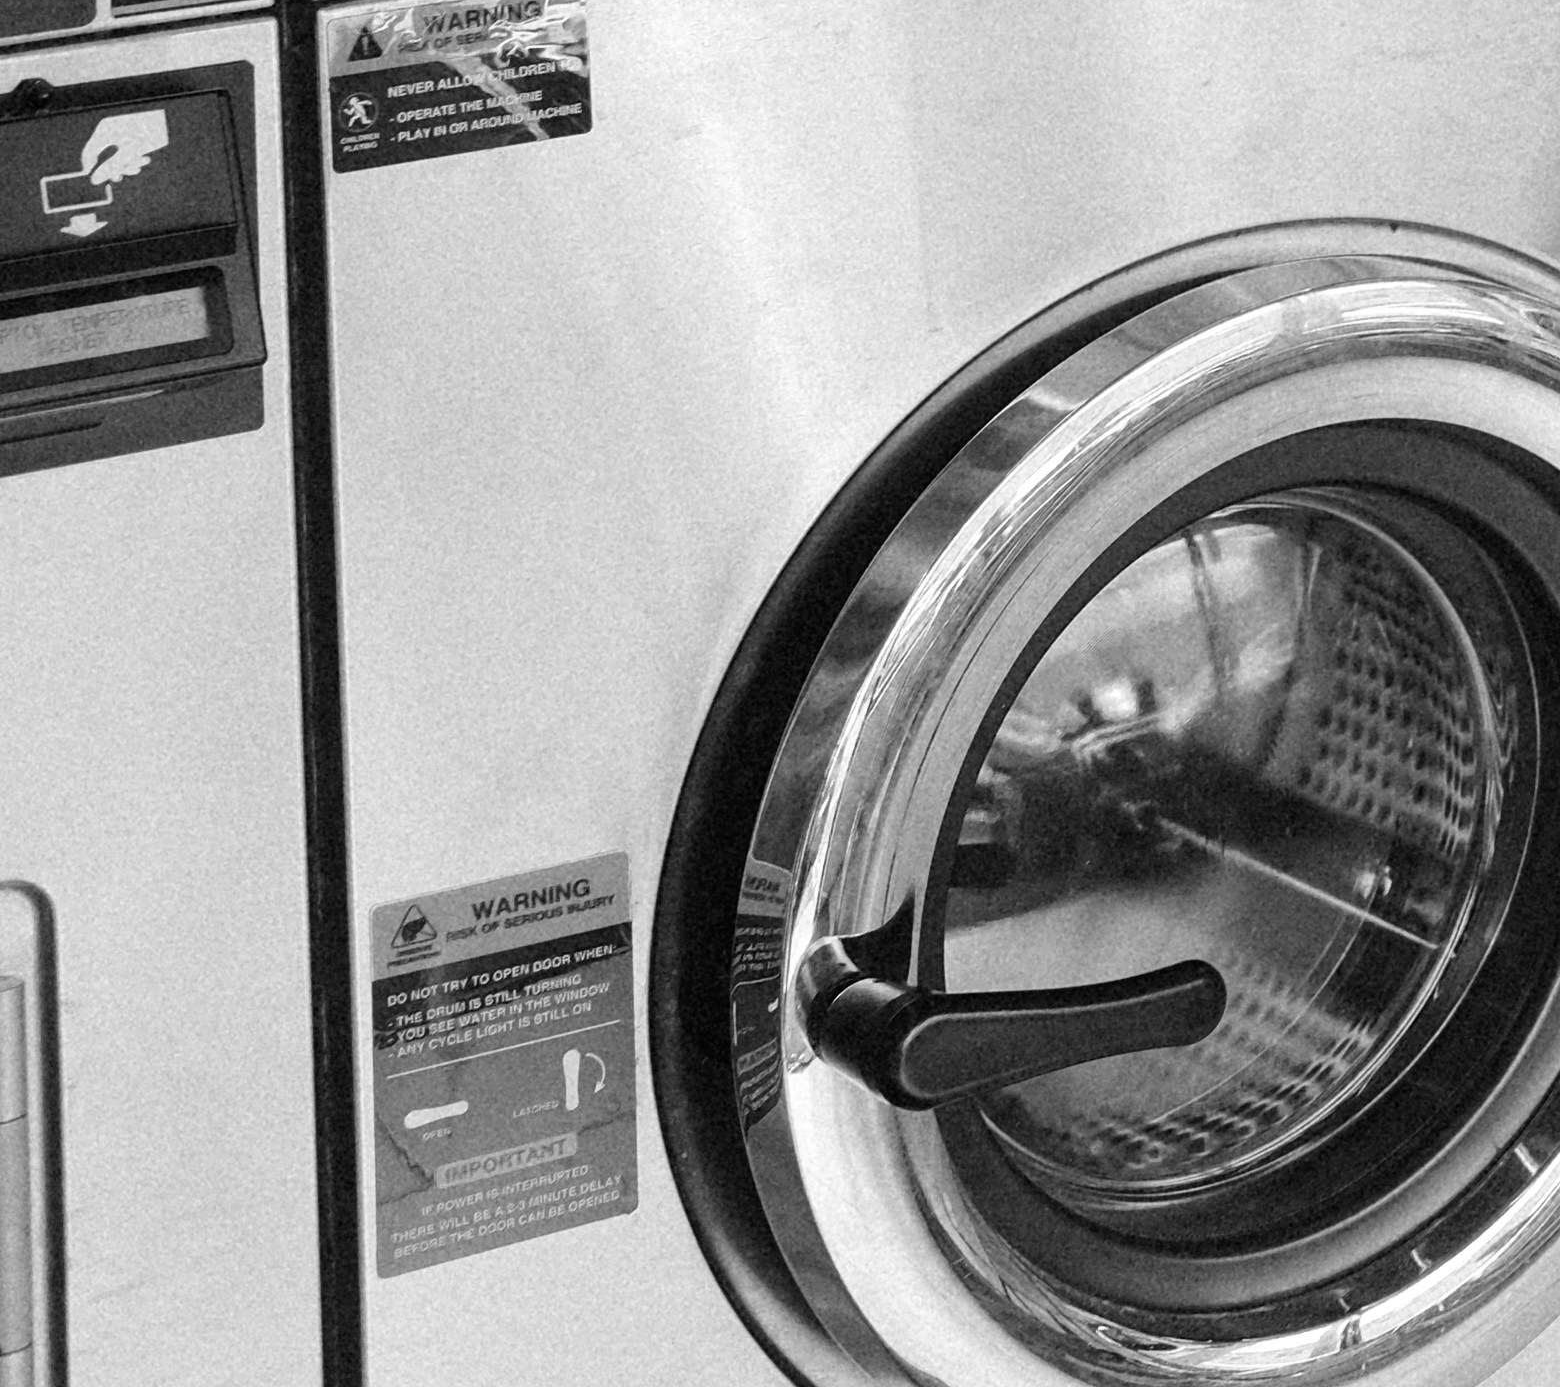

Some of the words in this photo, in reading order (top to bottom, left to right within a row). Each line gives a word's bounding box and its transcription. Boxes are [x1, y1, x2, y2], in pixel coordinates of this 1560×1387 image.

[423, 0, 542, 34] WARNING
[387, 80, 435, 98] NEVER
[437, 73, 485, 91] ALLOW
[488, 62, 556, 82] CHILDREN
[396, 103, 457, 123] OPERATE
[459, 98, 485, 112] THE
[486, 90, 543, 109] MACHINE
[397, 127, 431, 143] PLAY
[433, 125, 448, 136] IN
[449, 120, 469, 134] OR
[470, 111, 524, 131] AROUND
[526, 102, 583, 122] MACHINE
[446, 927, 478, 942] RISK
[481, 921, 500, 934] OF
[504, 906, 563, 929] SERIOUS
[567, 893, 616, 915] INJURY
[471, 878, 591, 921] WARNING
[387, 993, 408, 1008] DO
[410, 984, 440, 1002] NOT
[442, 977, 470, 995] TRY
[472, 972, 490, 987] TO
[493, 963, 530, 983] OPEN
[532, 954, 571, 974] DOOR
[574, 944, 618, 963] WHEN:
[396, 1012, 423, 1028] THE
[427, 1001, 466, 1021] DRUM
[469, 998, 483, 1012] IS
[485, 989, 521, 1007] STILL
[524, 973, 582, 998] TURNING
[397, 1025, 426, 1043] YOU
[429, 1018, 456, 1035] SEE
[458, 1007, 507, 1028] WATER
[509, 1002, 523, 1016] IN
[525, 996, 552, 1013] THE
[554, 982, 611, 1004] WINDOW
[397, 1042, 426, 1058] ANY
[428, 1029, 474, 1051] CYCLE
[476, 1019, 516, 1040] LIGHT
[518, 1016, 532, 1030] IS
[533, 1007, 570, 1025] STILL
[572, 999, 593, 1015] ON
[444, 1136, 569, 1183] IMPORTANT
[390, 1222, 436, 1244] THERE
[439, 1215, 471, 1233] WILL
[474, 1209, 492, 1224] BE
[507, 1199, 526, 1214] 2-3
[529, 1186, 577, 1209] MINUTE
[579, 1174, 624, 1195] DELAY
[421, 1203, 435, 1217] IF
[436, 1191, 485, 1214] POWER
[486, 1186, 500, 1201] IS
[501, 1164, 590, 1197] INTERRUPTED
[393, 1237, 448, 1261] BEFORE
[450, 1228, 476, 1245] THE
[478, 1217, 516, 1237] DOOR
[518, 1209, 547, 1226] CAN
[548, 1203, 567, 1219] BE
[568, 1189, 621, 1213] OPENED
